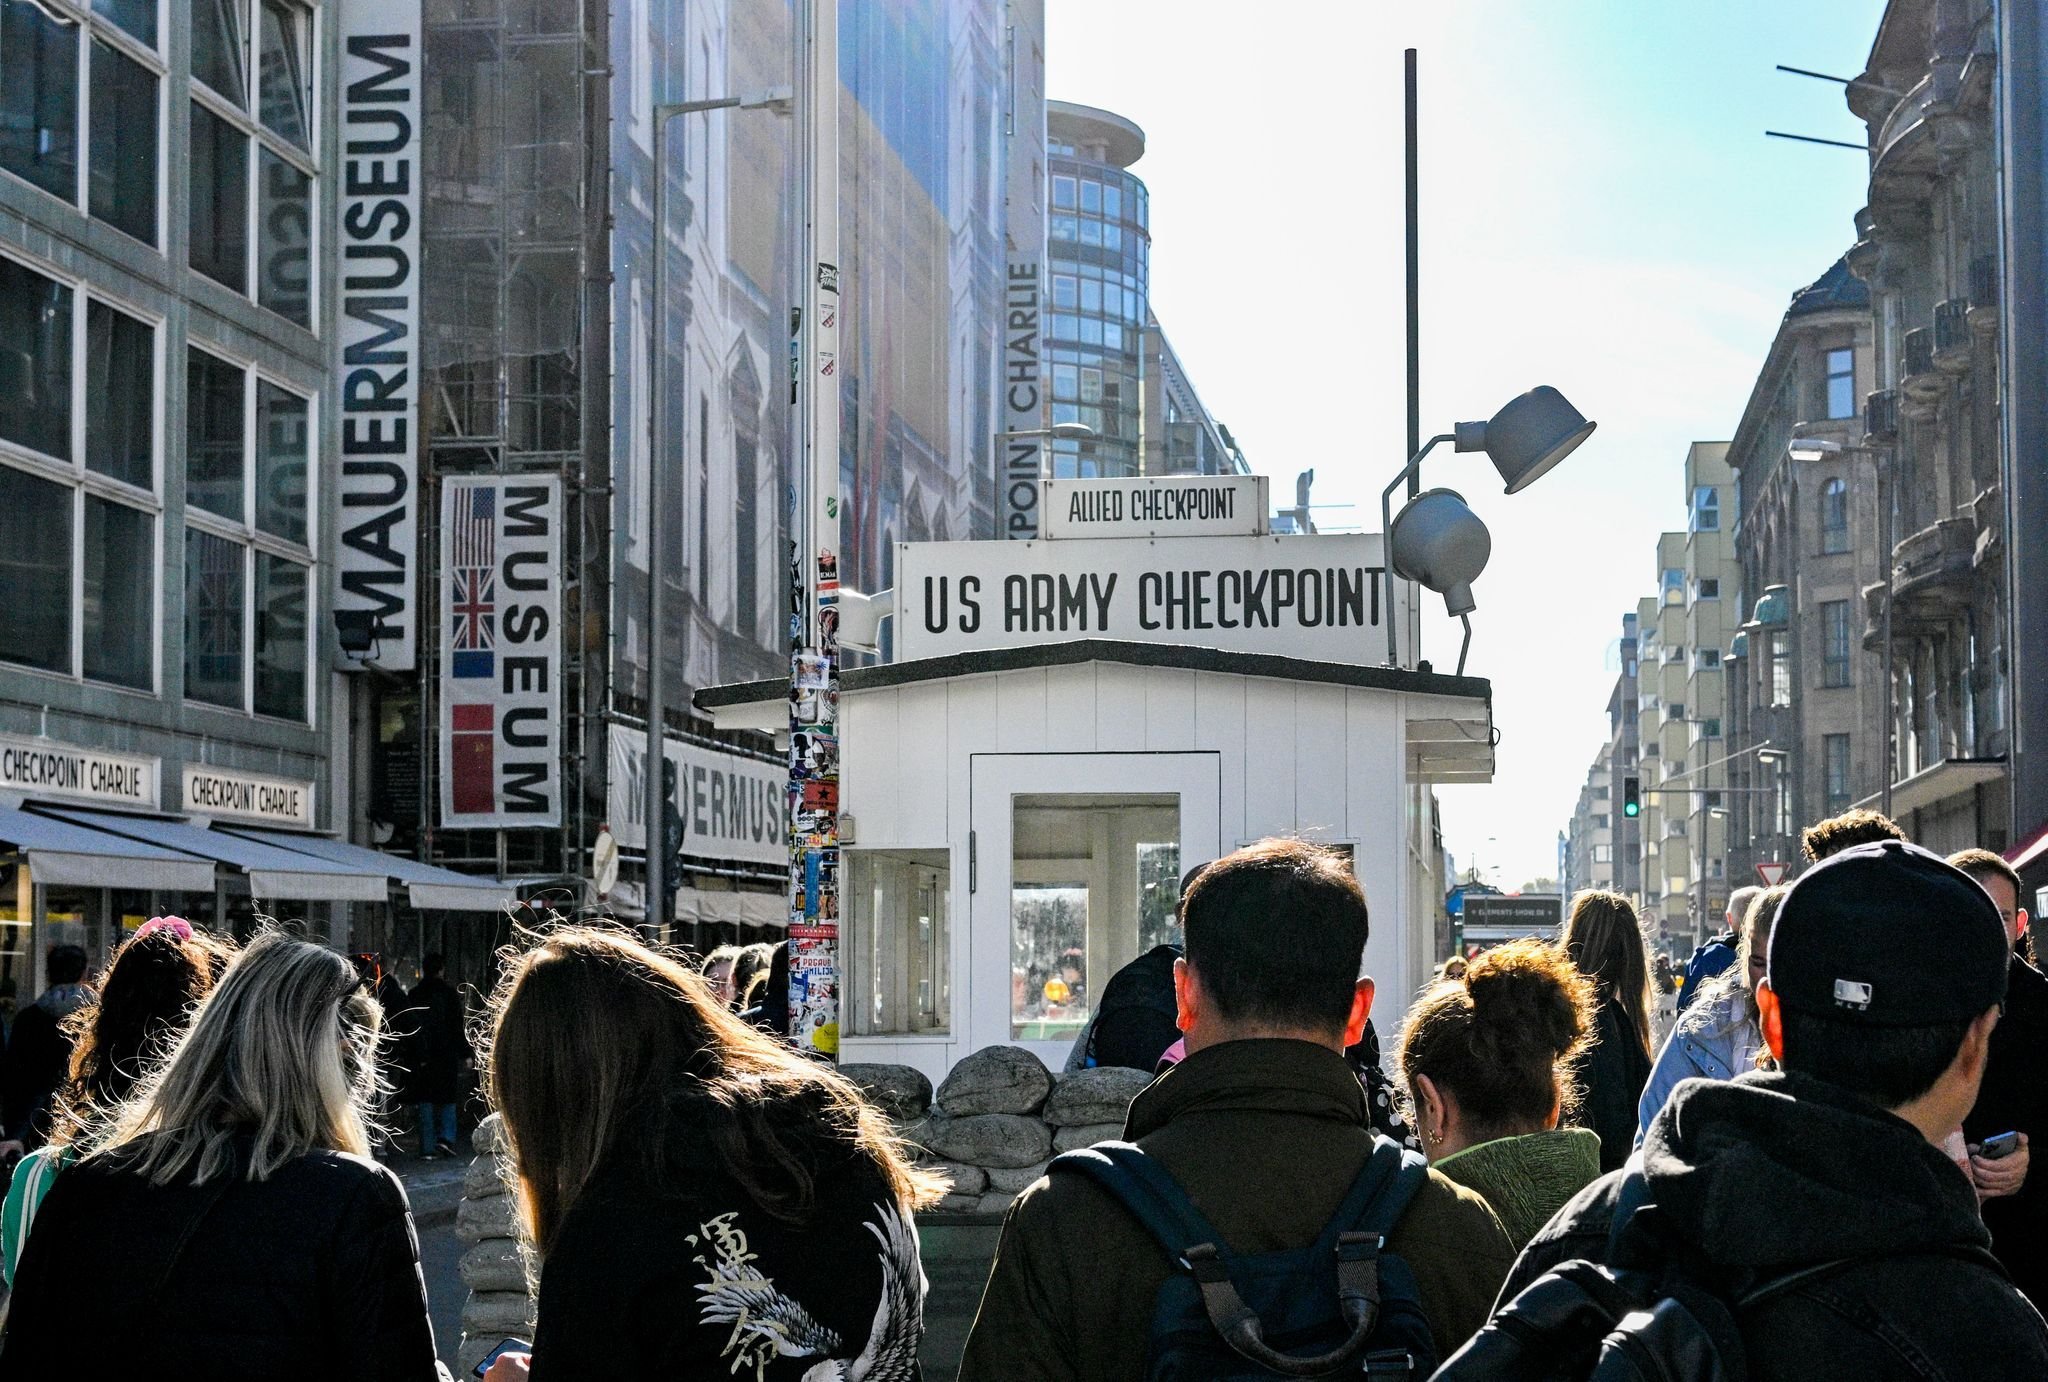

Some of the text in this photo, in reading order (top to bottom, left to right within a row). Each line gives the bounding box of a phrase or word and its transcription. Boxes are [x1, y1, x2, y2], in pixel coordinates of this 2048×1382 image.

[342, 34, 411, 639] MAUERMUSEUM
[1007, 263, 1038, 413] CHARLIE
[1069, 487, 1236, 522] ALLIED CHECKPOINT
[1004, 572, 1118, 633] ARMY
[1138, 567, 1386, 631] CHECKPOINT
[502, 487, 550, 813] MUSEUM
[3, 748, 141, 797] CHECKPOINT CHARLIE
[191, 776, 298, 817] CHECKPOINT CHARLIE
[627, 750, 790, 846] MUERMUSE
